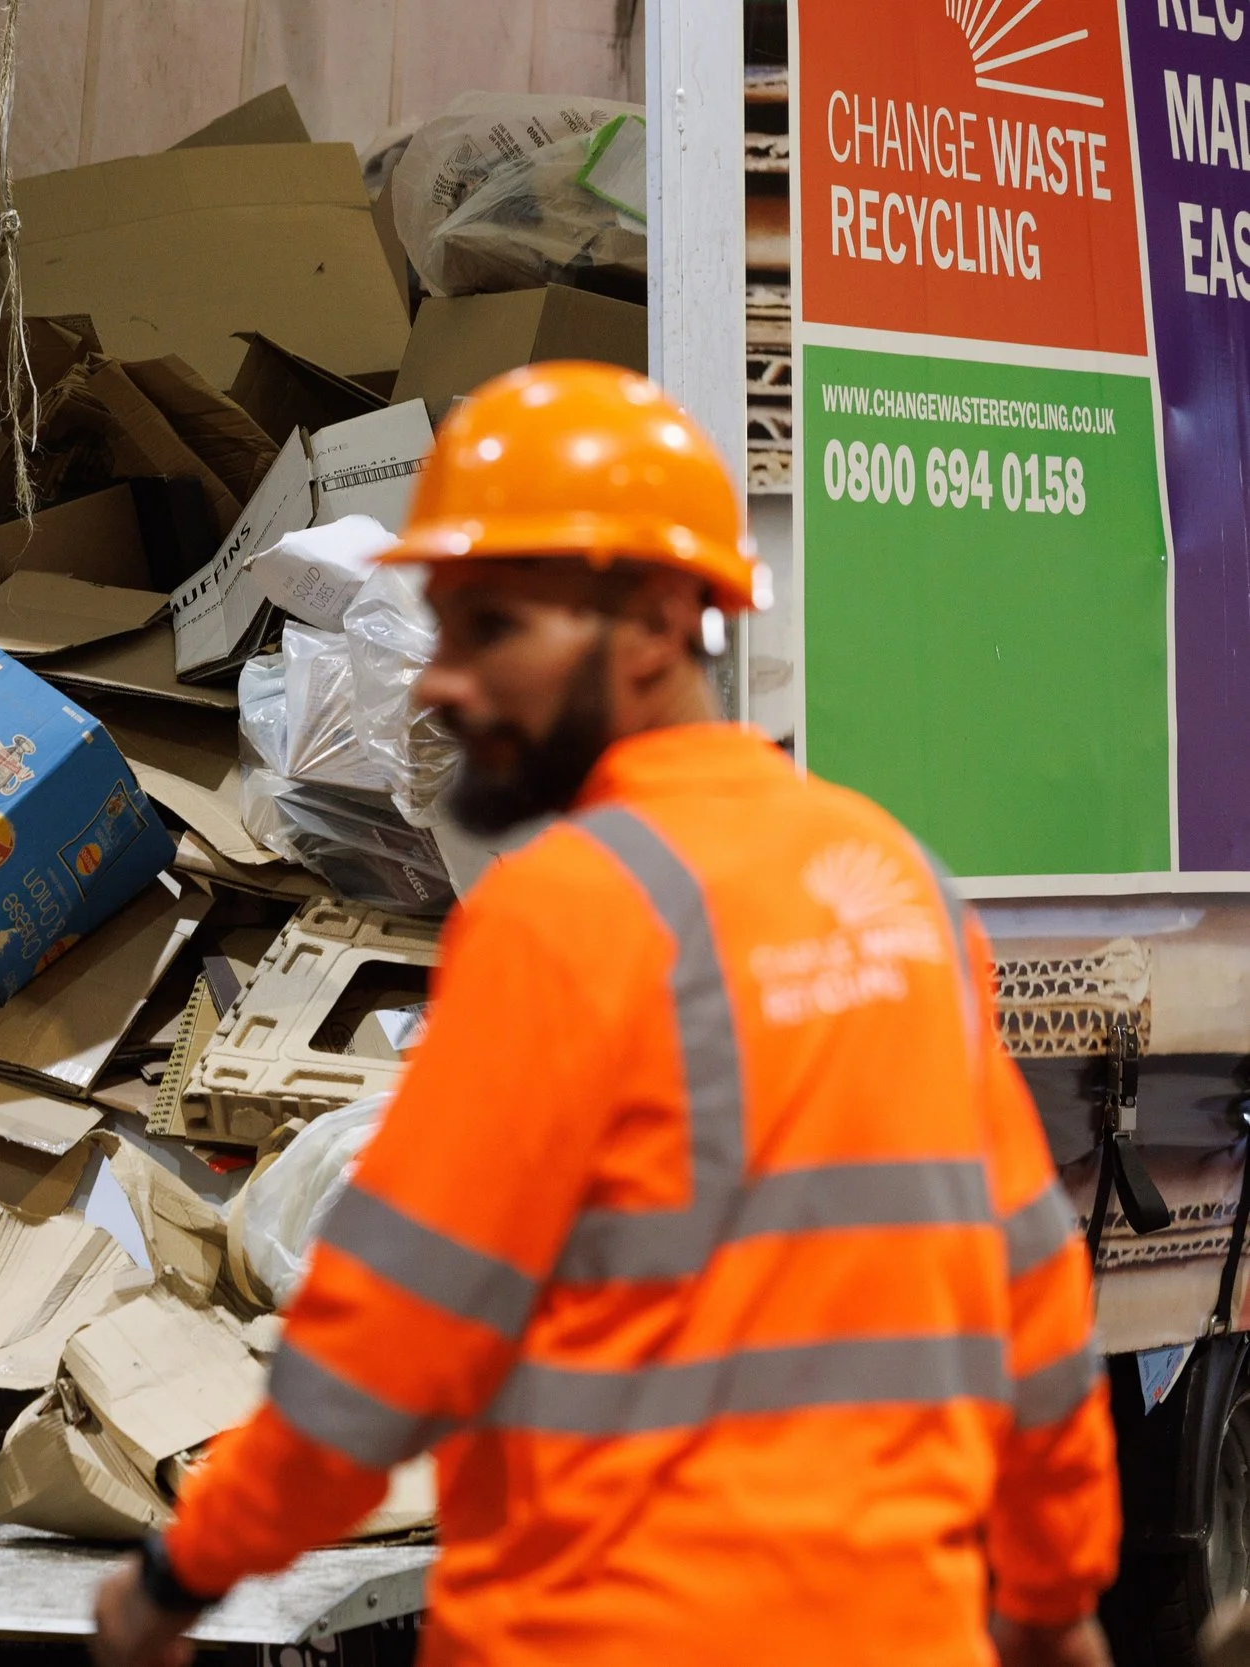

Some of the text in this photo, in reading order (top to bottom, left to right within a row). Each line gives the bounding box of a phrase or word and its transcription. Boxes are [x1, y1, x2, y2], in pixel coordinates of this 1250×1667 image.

[526, 126, 545, 148] 0800
[827, 90, 1112, 201] CHANGE WASTE
[830, 184, 1041, 280] RECYCLING
[821, 383, 1116, 435] WWW.CHANGEWASTERECYCLING.CO.UK
[333, 463, 367, 475] Muffin
[823, 438, 1086, 516] 0800 694 0158
[292, 566, 321, 601] SQUID
[310, 582, 336, 611] TUBES
[22, 867, 60, 927] Onion
[2, 892, 43, 961] Cheese
